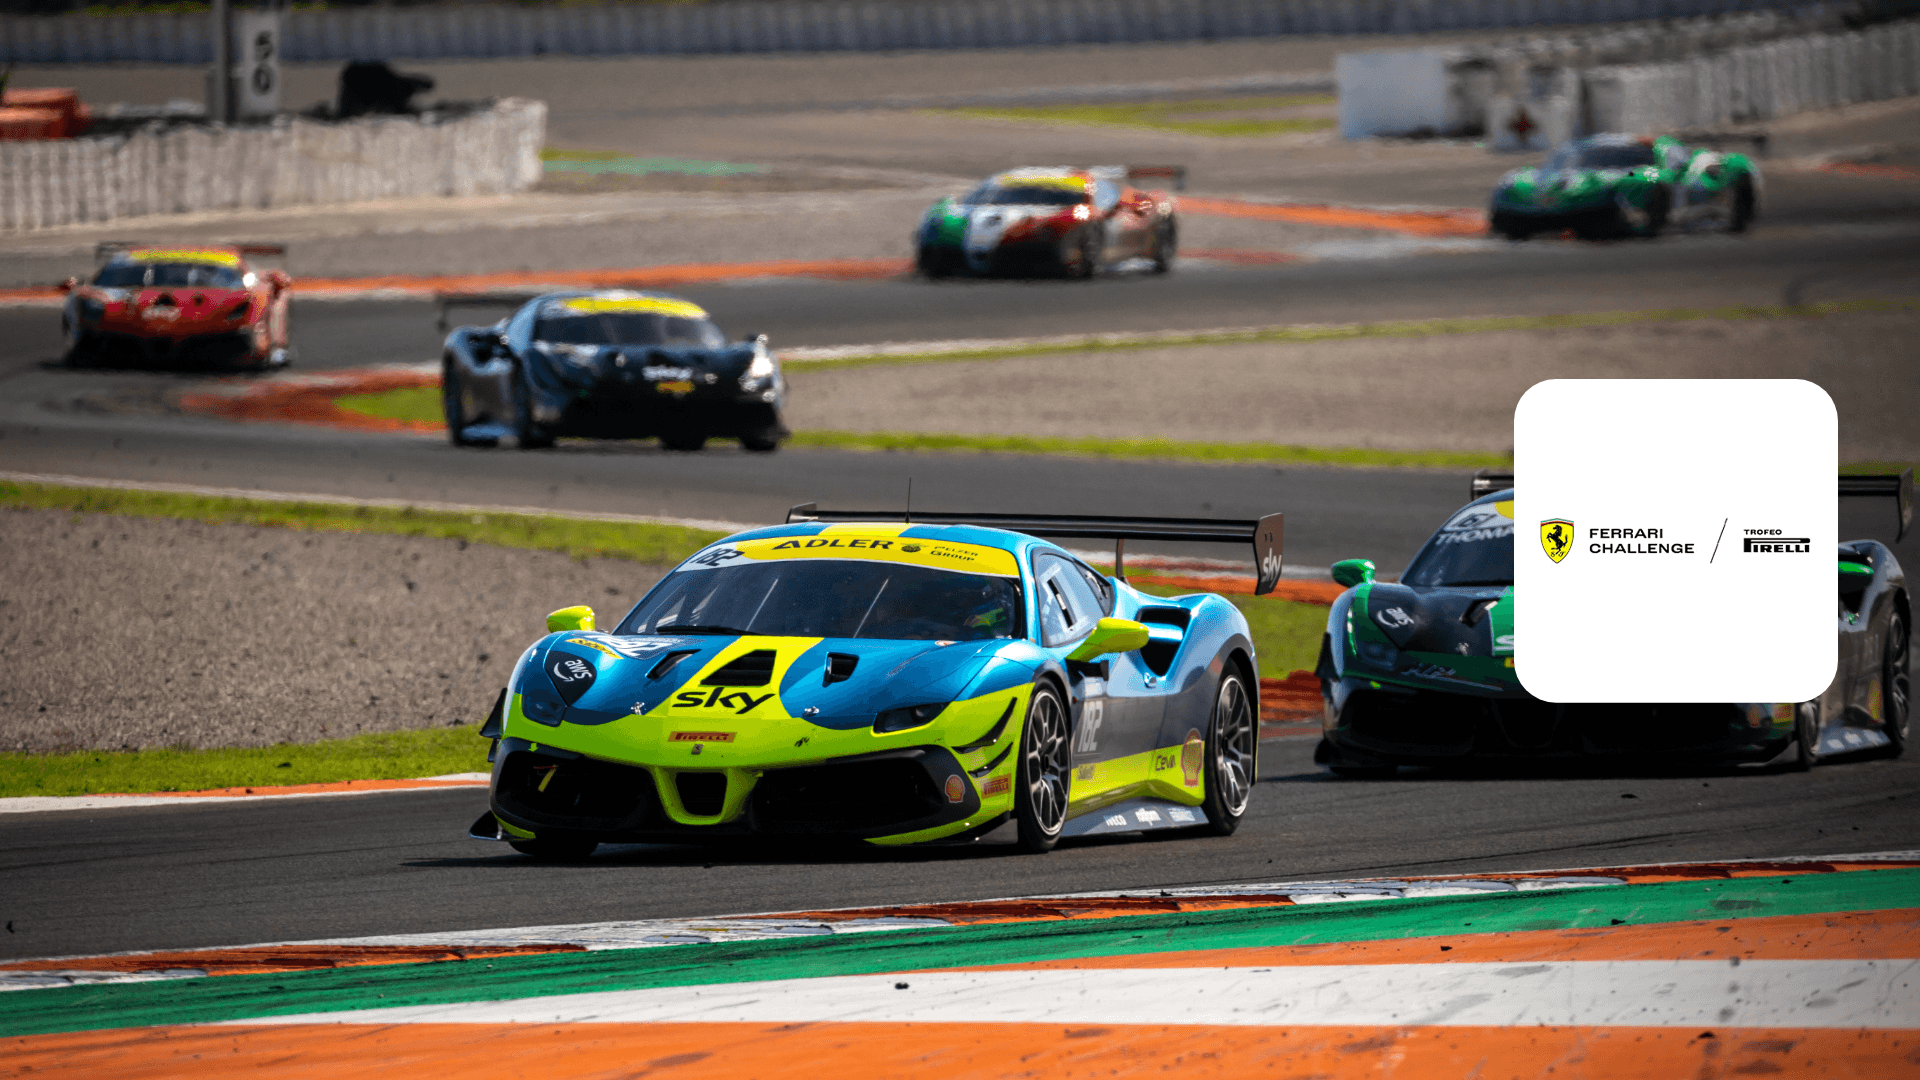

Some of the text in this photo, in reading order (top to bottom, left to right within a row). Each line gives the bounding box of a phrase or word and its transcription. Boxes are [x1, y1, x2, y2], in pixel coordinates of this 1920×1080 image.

[253, 31, 274, 95] 50
[689, 547, 746, 567] 182
[771, 539, 894, 551] ADLER
[1261, 547, 1283, 589] sky
[564, 658, 593, 680] aws
[671, 686, 777, 715] sky
[1077, 700, 1104, 753] 182
